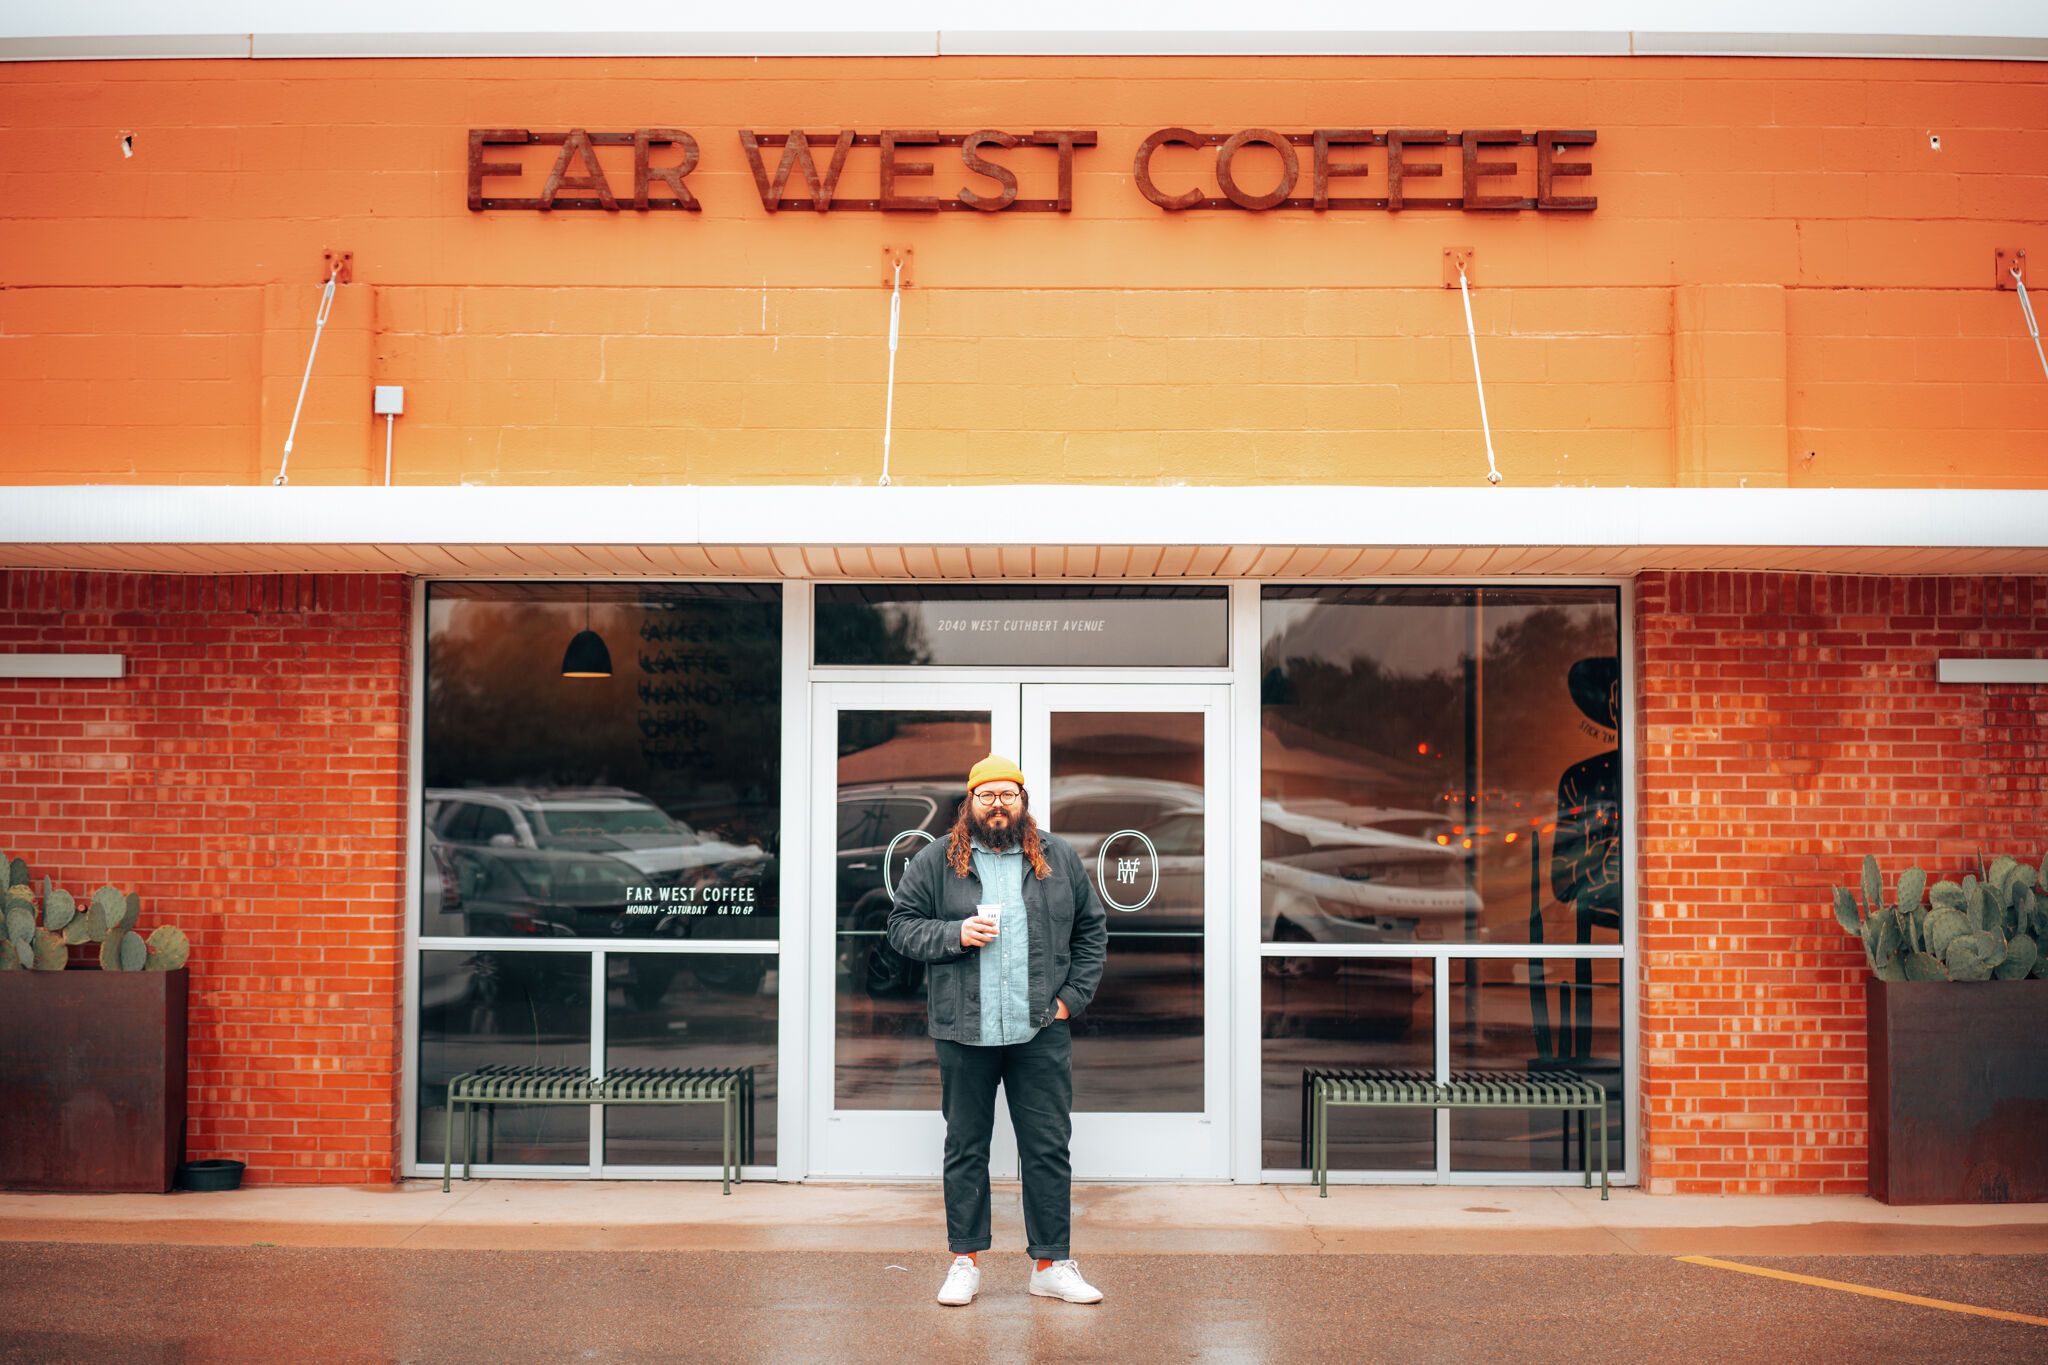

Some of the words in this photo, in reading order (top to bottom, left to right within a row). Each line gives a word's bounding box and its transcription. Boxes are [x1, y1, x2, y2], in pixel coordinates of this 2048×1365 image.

[468, 128, 702, 211] FAR
[739, 128, 1098, 211] WEST
[1134, 127, 1597, 211] COFFEE
[938, 619, 966, 632] 2040
[971, 619, 999, 632] WEST
[1003, 619, 1058, 632] CUTHBERT
[1062, 619, 1105, 632] AVENUE
[626, 886, 653, 902] FAR
[659, 886, 697, 902] WEST
[702, 886, 756, 902] COFFEE
[626, 905, 658, 915] MONDAY
[667, 905, 708, 915] SATURDAY
[717, 905, 728, 915] 6A
[731, 905, 742, 915] TO
[742, 905, 754, 915] 6P
